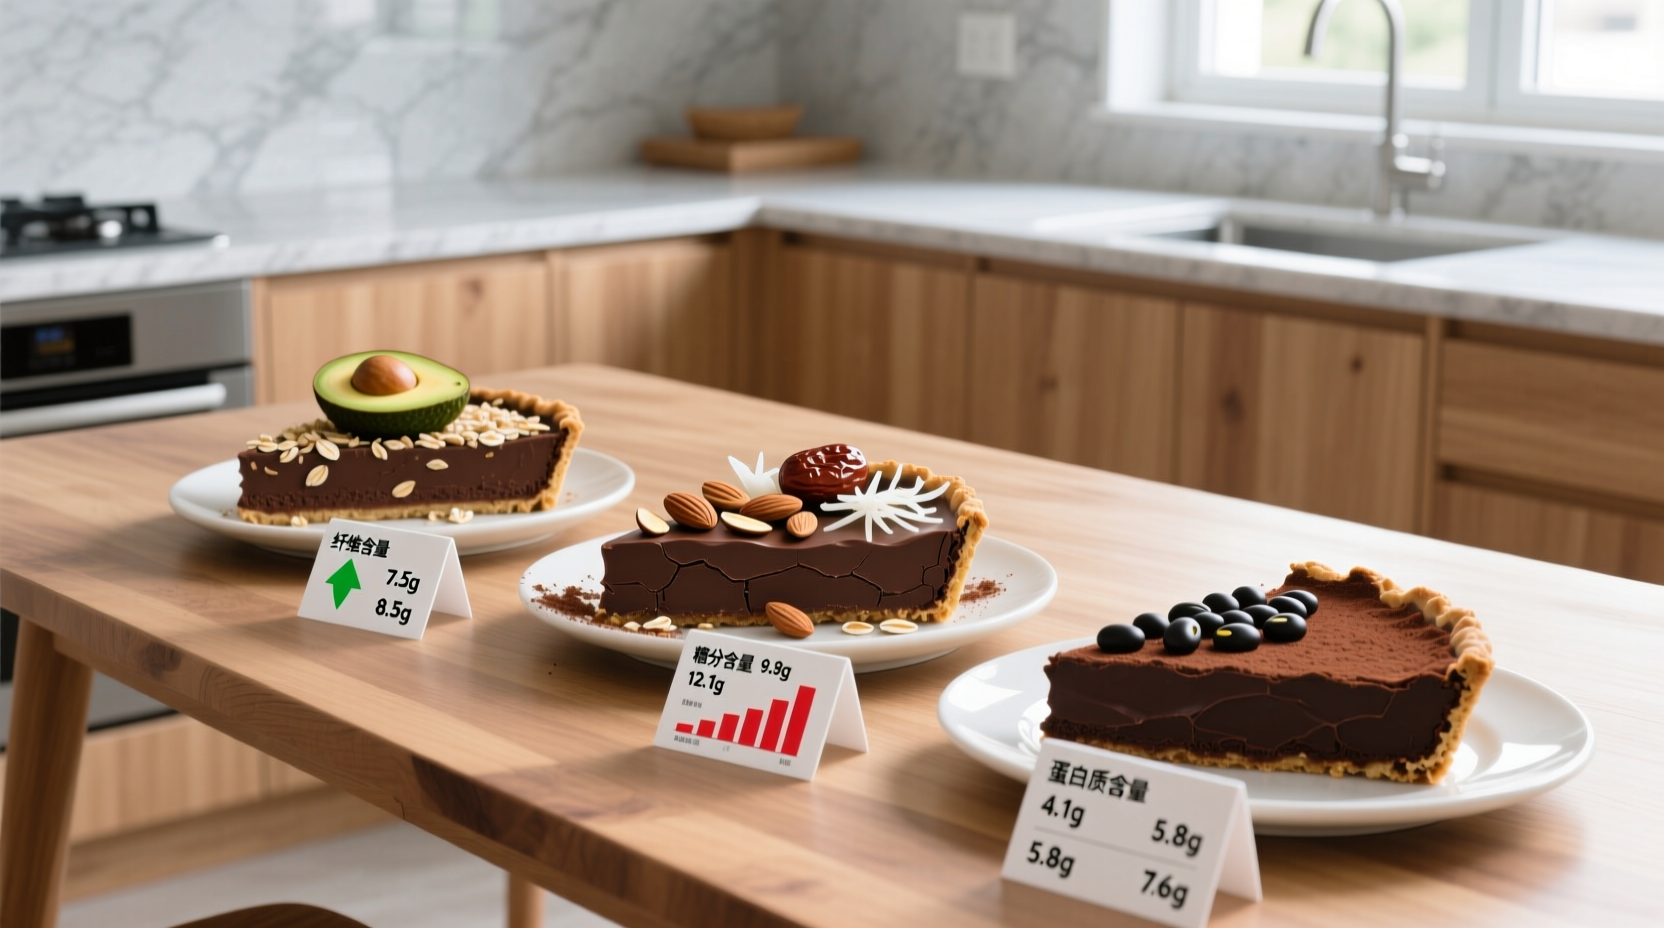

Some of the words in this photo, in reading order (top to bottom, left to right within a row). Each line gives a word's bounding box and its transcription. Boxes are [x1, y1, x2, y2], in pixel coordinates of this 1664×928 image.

[386, 569, 420, 594] 7.5g
[375, 598, 412, 625] 8.5g
[688, 671, 725, 695] 12.1g
[1048, 760, 1150, 803] 蛋白质含量
[1041, 795, 1085, 829] 4.1g
[1151, 820, 1203, 857] 5.8g
[1027, 841, 1075, 878] 5.8g
[1141, 870, 1189, 909] 7.6g
